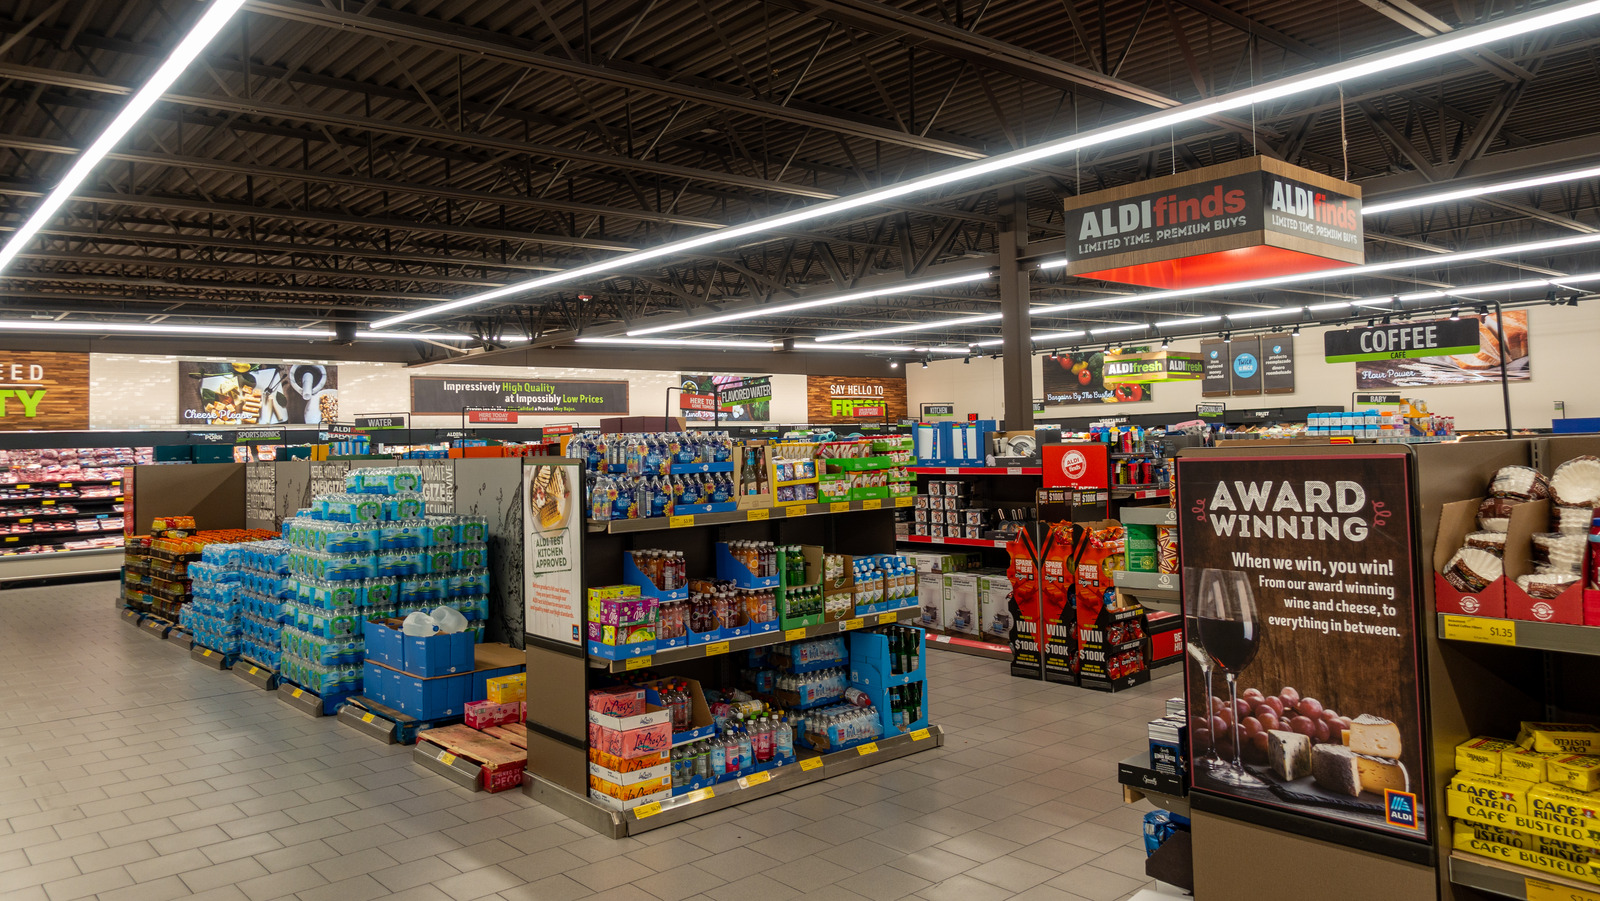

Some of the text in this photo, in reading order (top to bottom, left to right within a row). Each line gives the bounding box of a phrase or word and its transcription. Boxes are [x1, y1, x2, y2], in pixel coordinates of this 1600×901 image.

[1078, 216, 1247, 255] LIMITED TIME, PREMIUM BUYS
[1272, 214, 1358, 245] LIMITED TIME, PREMIUM BUYS
[1360, 325, 1438, 353] COFFEE
[1390, 351, 1407, 360] CAFÉ
[1362, 369, 1416, 380] Flour Power
[443, 381, 556, 395] Impressively High Quality
[722, 385, 772, 403] FLAVORED WATER
[830, 385, 884, 395] SAY HELLO TO
[505, 394, 604, 406] at Impossibly Low Prices
[1048, 393, 1073, 402] Bargains
[1073, 392, 1082, 401] By
[1082, 391, 1094, 400] The
[1370, 395, 1387, 404] BABY
[184, 410, 253, 420] Cheese Please
[1099, 417, 1127, 425] VEGETABLES
[368, 419, 392, 428] WATER
[421, 466, 445, 481] YDRATE
[1069, 464, 1082, 473] finds
[312, 481, 344, 495] ENERGIZE
[446, 465, 454, 503] REVIVE
[423, 484, 446, 502] GIZE
[1209, 480, 1366, 513] AWARD
[1209, 513, 1369, 542] WINNING
[536, 536, 564, 547] ALDI TEST
[538, 547, 564, 558] KITCHEN
[536, 557, 567, 569] APPROVED
[1015, 559, 1033, 567] SPARK
[1045, 561, 1063, 569] SPARK
[1079, 565, 1098, 573] SPARK
[1232, 552, 1394, 578] When we win, you win!
[1259, 575, 1395, 600] From our award winning
[1284, 597, 1397, 618] wine and cheese, to
[1016, 621, 1037, 634] WIN
[1046, 624, 1067, 638] WIN
[1269, 615, 1401, 637] everything in between.
[1490, 627, 1513, 638] $1.35
[1080, 629, 1103, 643] WIN
[1015, 639, 1039, 652] $100K
[1045, 643, 1069, 656] $100K
[1080, 649, 1106, 662] $100K
[602, 701, 635, 716] LaCroix
[633, 732, 667, 752] LaCroix
[1554, 739, 1591, 747] BUSTELO
[1391, 812, 1412, 822] ALDI
[1534, 810, 1585, 827] BUSTEL
[1516, 817, 1584, 840] BUSTELO
[1474, 828, 1523, 849] USTELO
[1540, 845, 1590, 864] BUSTEL
[1520, 851, 1586, 875] BUSTELO
